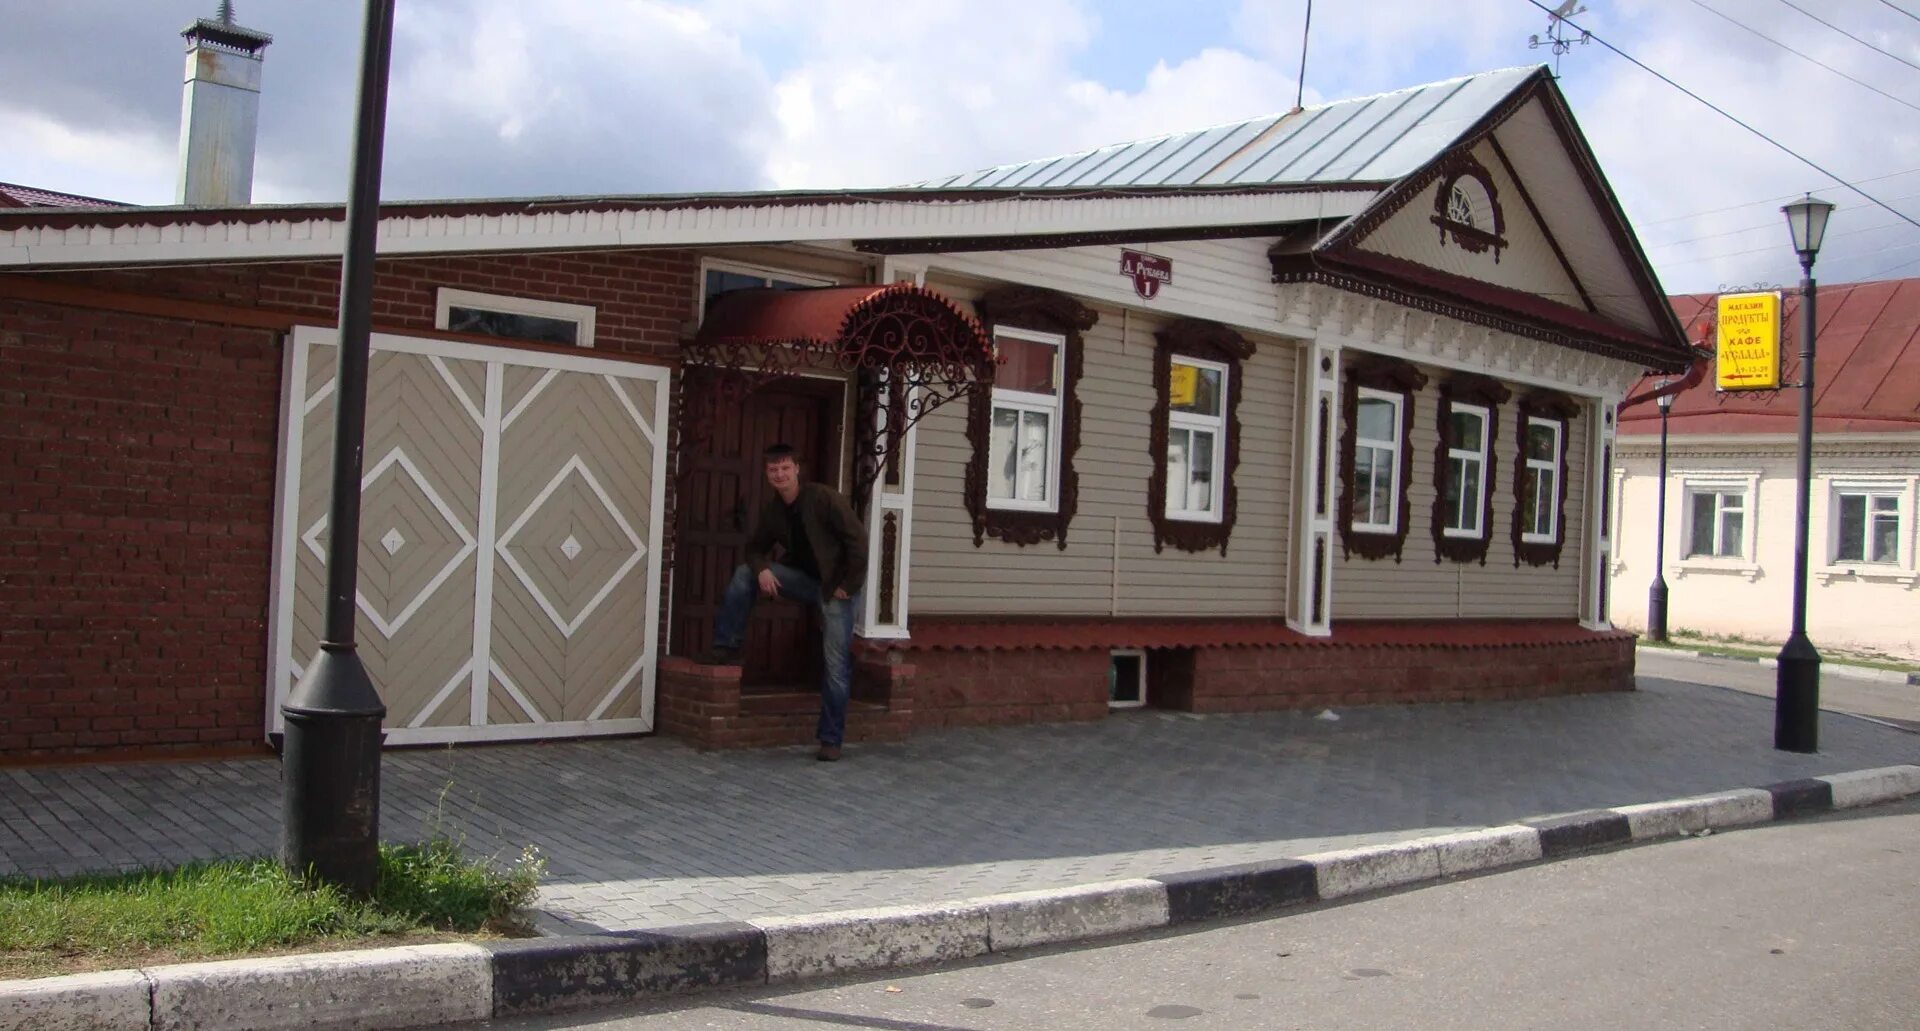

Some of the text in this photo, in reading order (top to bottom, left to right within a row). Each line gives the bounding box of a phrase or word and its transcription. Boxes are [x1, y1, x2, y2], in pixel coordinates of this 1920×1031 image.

[1144, 281, 1151, 296] 1
[1728, 303, 1763, 311] МАГАЗИН
[1722, 313, 1768, 325] ПРОДУКТЫ
[1729, 337, 1761, 346] КАФЕ
